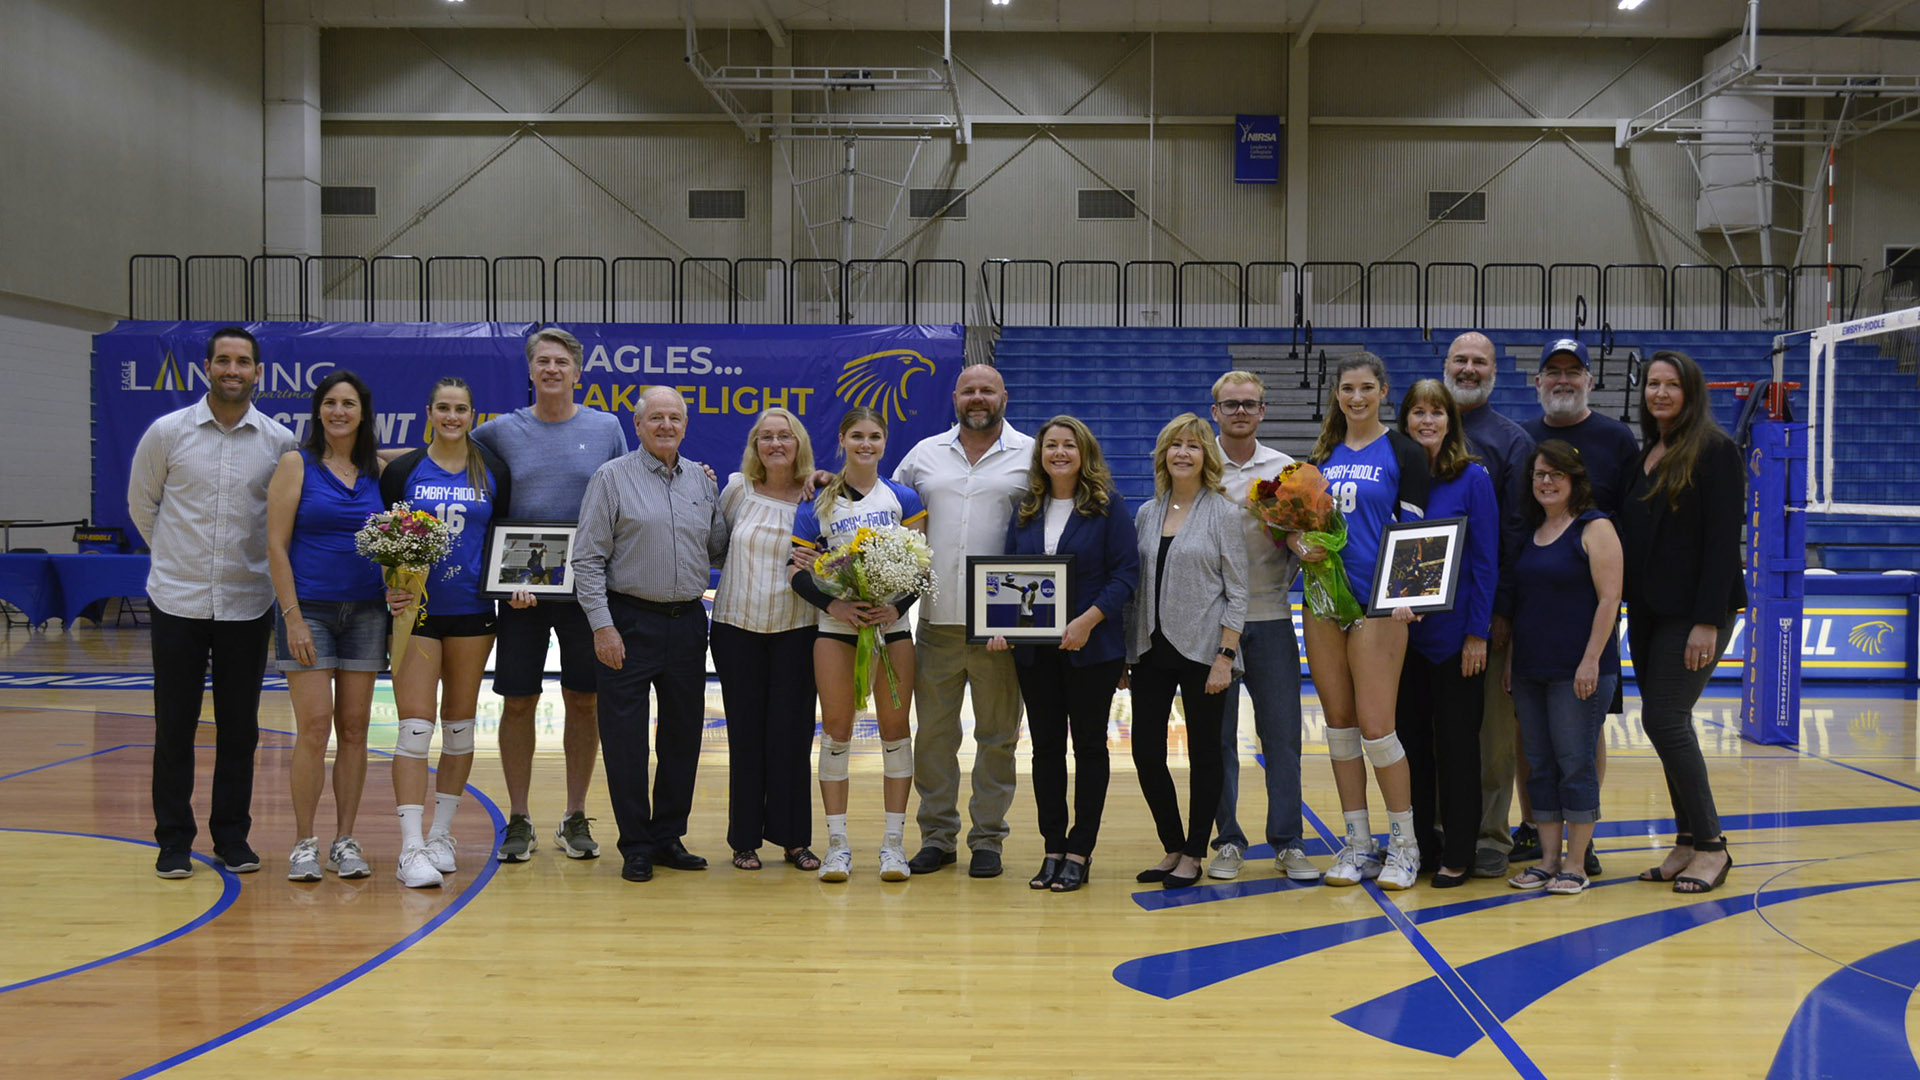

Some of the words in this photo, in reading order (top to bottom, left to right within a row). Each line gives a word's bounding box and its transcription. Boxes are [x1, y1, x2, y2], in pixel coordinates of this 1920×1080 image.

[1247, 133, 1277, 142] NIRSA
[1842, 318, 1886, 336] EMBRY-RIDDLE
[121, 361, 131, 390] EAGLE
[130, 349, 335, 391] LANING
[1331, 481, 1358, 513] 18
[435, 502, 467, 534] 16
